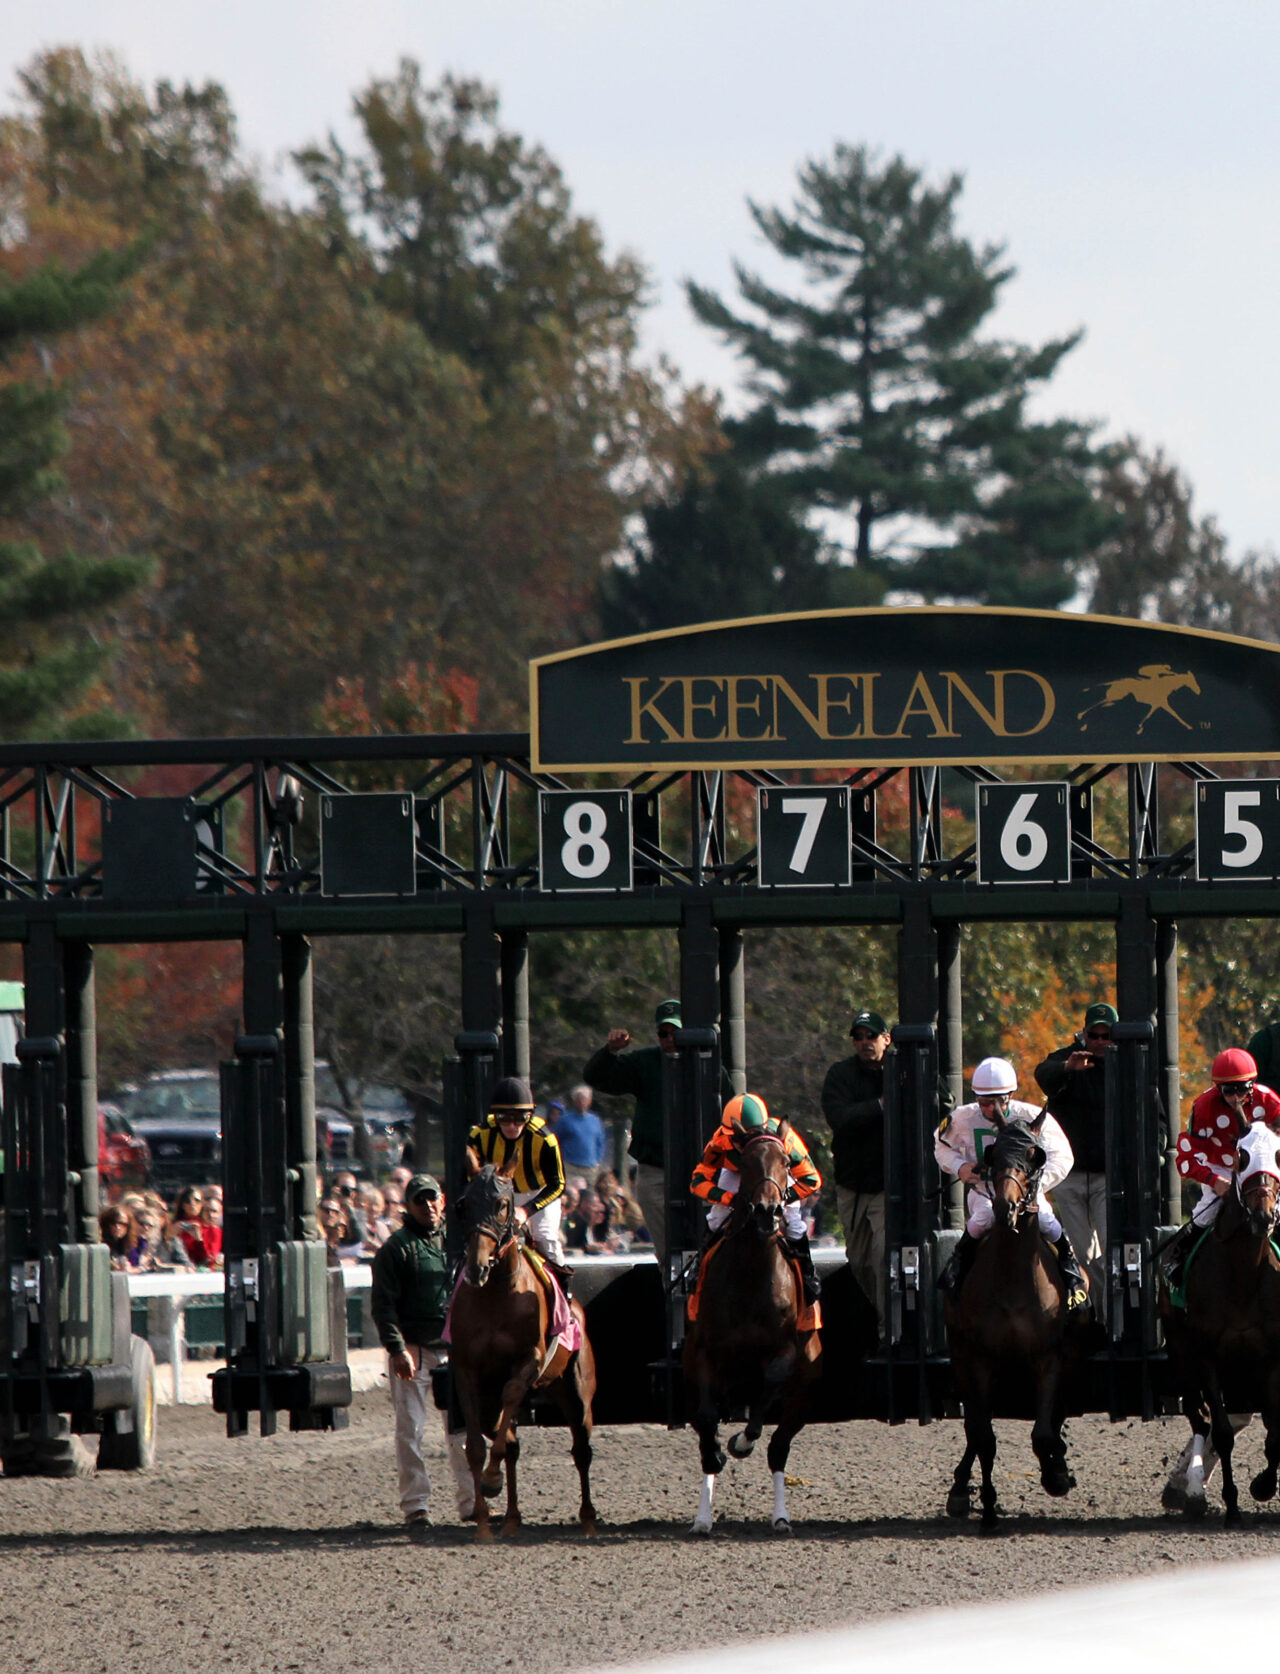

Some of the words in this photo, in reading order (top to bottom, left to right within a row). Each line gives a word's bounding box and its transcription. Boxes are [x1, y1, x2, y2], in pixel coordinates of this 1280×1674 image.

[623, 669, 1056, 744] KEENELAND
[561, 801, 611, 879] 8
[782, 797, 828, 874] 7
[1000, 793, 1048, 871] 6
[1221, 790, 1264, 868] 5
